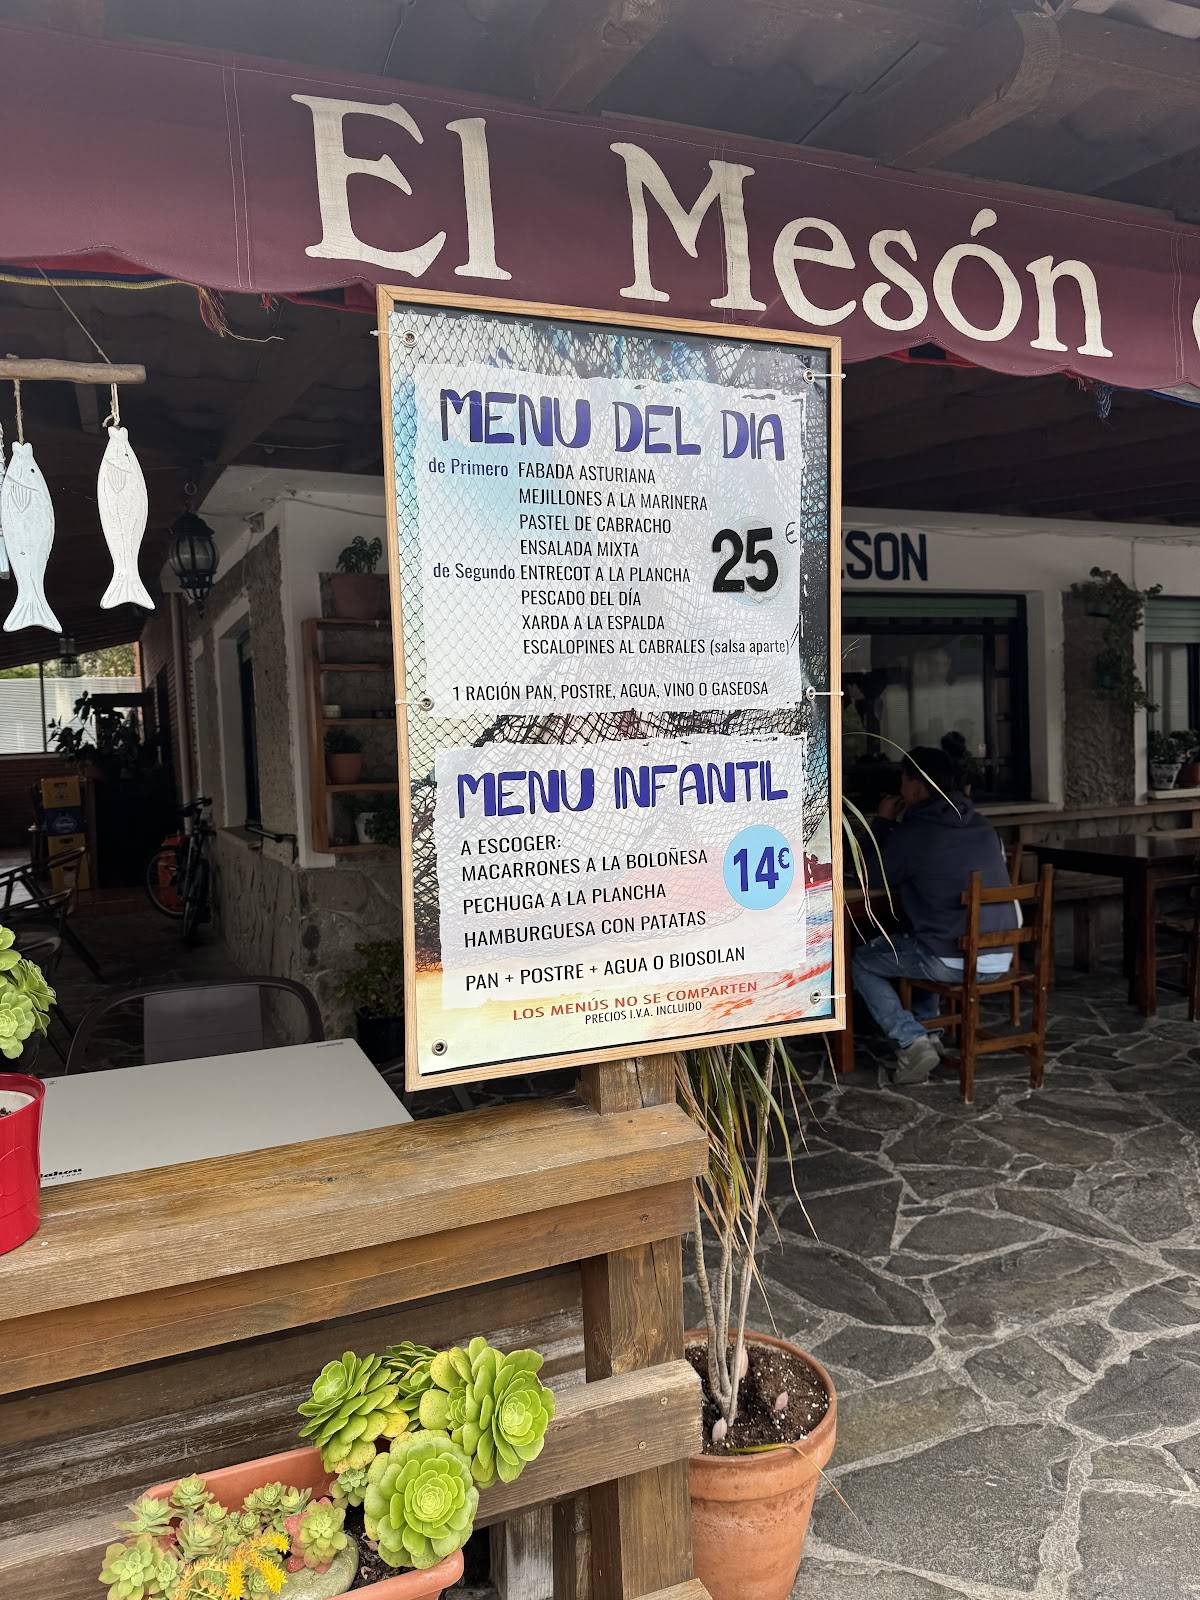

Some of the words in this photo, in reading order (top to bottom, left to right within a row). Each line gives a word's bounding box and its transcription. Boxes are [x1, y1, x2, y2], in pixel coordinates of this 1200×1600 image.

[290, 93, 512, 281] El
[609, 142, 1113, 358] Mesón
[440, 388, 591, 449] MENU
[612, 401, 702, 456] DEL
[720, 409, 785, 461] DIA
[428, 457, 446, 474] de
[451, 458, 509, 477] Primero
[518, 461, 575, 480] FABADA
[579, 465, 656, 484] ASTURIANA
[519, 488, 602, 507] MEJILLONES
[606, 491, 616, 507] A
[620, 492, 636, 508] LA
[640, 493, 708, 511] MARINERA
[519, 513, 570, 531] PASTEL
[575, 515, 592, 532] DE
[596, 516, 672, 534] CABRACHO
[520, 539, 593, 557] ENSALADA
[597, 541, 640, 558] MIXTA
[711, 526, 779, 593] 25
[841, 530, 928, 582] SON
[433, 562, 450, 578] de
[455, 562, 516, 582] Segundo
[520, 564, 590, 582] ENTRECOT
[595, 566, 604, 582] A
[609, 566, 625, 582] LA
[629, 567, 691, 583] PLANCHA
[521, 590, 585, 606] PESCADO
[590, 591, 614, 606] DEL
[619, 588, 641, 606] DÍA
[522, 614, 569, 630] XARDA
[573, 615, 582, 630] A
[587, 615, 603, 630] LA
[608, 615, 665, 630] ESPALDA
[523, 639, 615, 655] ESCALOPINES
[619, 640, 635, 654] AL
[639, 639, 705, 654] CABRALES
[710, 639, 745, 656] (salsa
[749, 639, 790, 656] aparte)
[452, 686, 460, 701] 1
[466, 681, 520, 701] RACIÓN
[526, 684, 557, 701] PAN,
[561, 684, 616, 700] POSTRE,
[620, 683, 660, 698] AGUA,
[664, 682, 694, 697] VINO
[699, 681, 707, 696] O
[711, 681, 769, 696] GASEOSA
[457, 768, 595, 818] MENU
[613, 760, 789, 809] INFANTIL
[461, 840, 472, 856] A
[478, 834, 562, 855] ESCOGER:
[462, 858, 580, 882] MACARRONES
[586, 857, 597, 873] A
[602, 855, 621, 871] LA
[626, 847, 708, 869] BOLOÑESA
[733, 846, 790, 892] 14€
[463, 893, 545, 915] PECHUGA
[550, 891, 562, 907] A
[567, 889, 587, 906] LA
[592, 883, 667, 904] PLANCHA
[464, 921, 596, 948] HAMBURGUESA
[601, 917, 635, 935] CON
[641, 910, 706, 931] PATATAS
[466, 972, 499, 991] PAN
[504, 974, 514, 983] +
[520, 963, 584, 985] POSTRE
[589, 965, 598, 974] +
[604, 957, 648, 976] AGUA
[653, 955, 664, 970] O
[669, 946, 745, 969] BIOSOLAN
[513, 1007, 545, 1021] LOS
[550, 998, 609, 1016] MENÚS
[614, 995, 638, 1009] NO
[643, 993, 661, 1005] SE
[666, 981, 757, 1002] COMPARTEN
[585, 1011, 627, 1025] PRECIOS
[630, 1008, 653, 1019] I.V.A.
[656, 1001, 702, 1015] INCLUIDO
